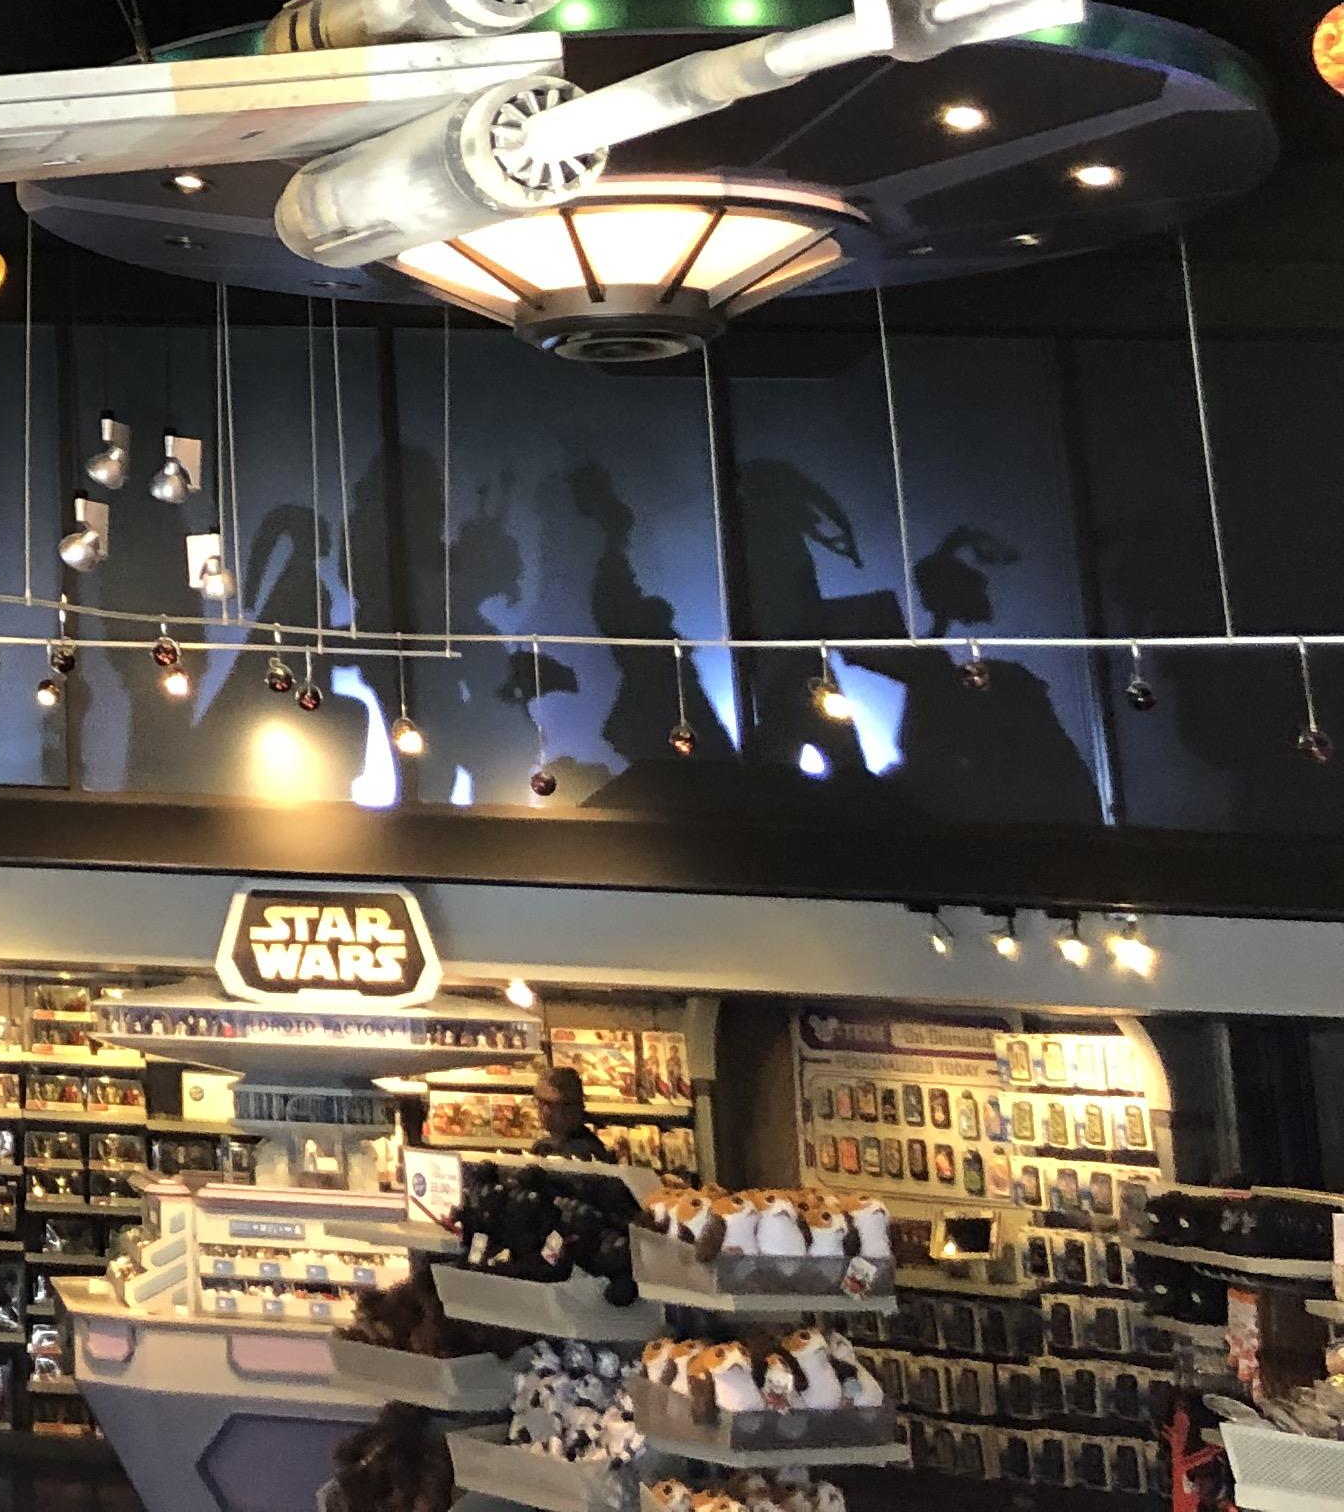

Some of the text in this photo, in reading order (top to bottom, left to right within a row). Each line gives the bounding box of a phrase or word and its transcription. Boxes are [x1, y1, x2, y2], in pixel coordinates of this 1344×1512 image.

[249, 906, 406, 942] STAR
[250, 943, 407, 983] WARS
[259, 1019, 316, 1034] DROID
